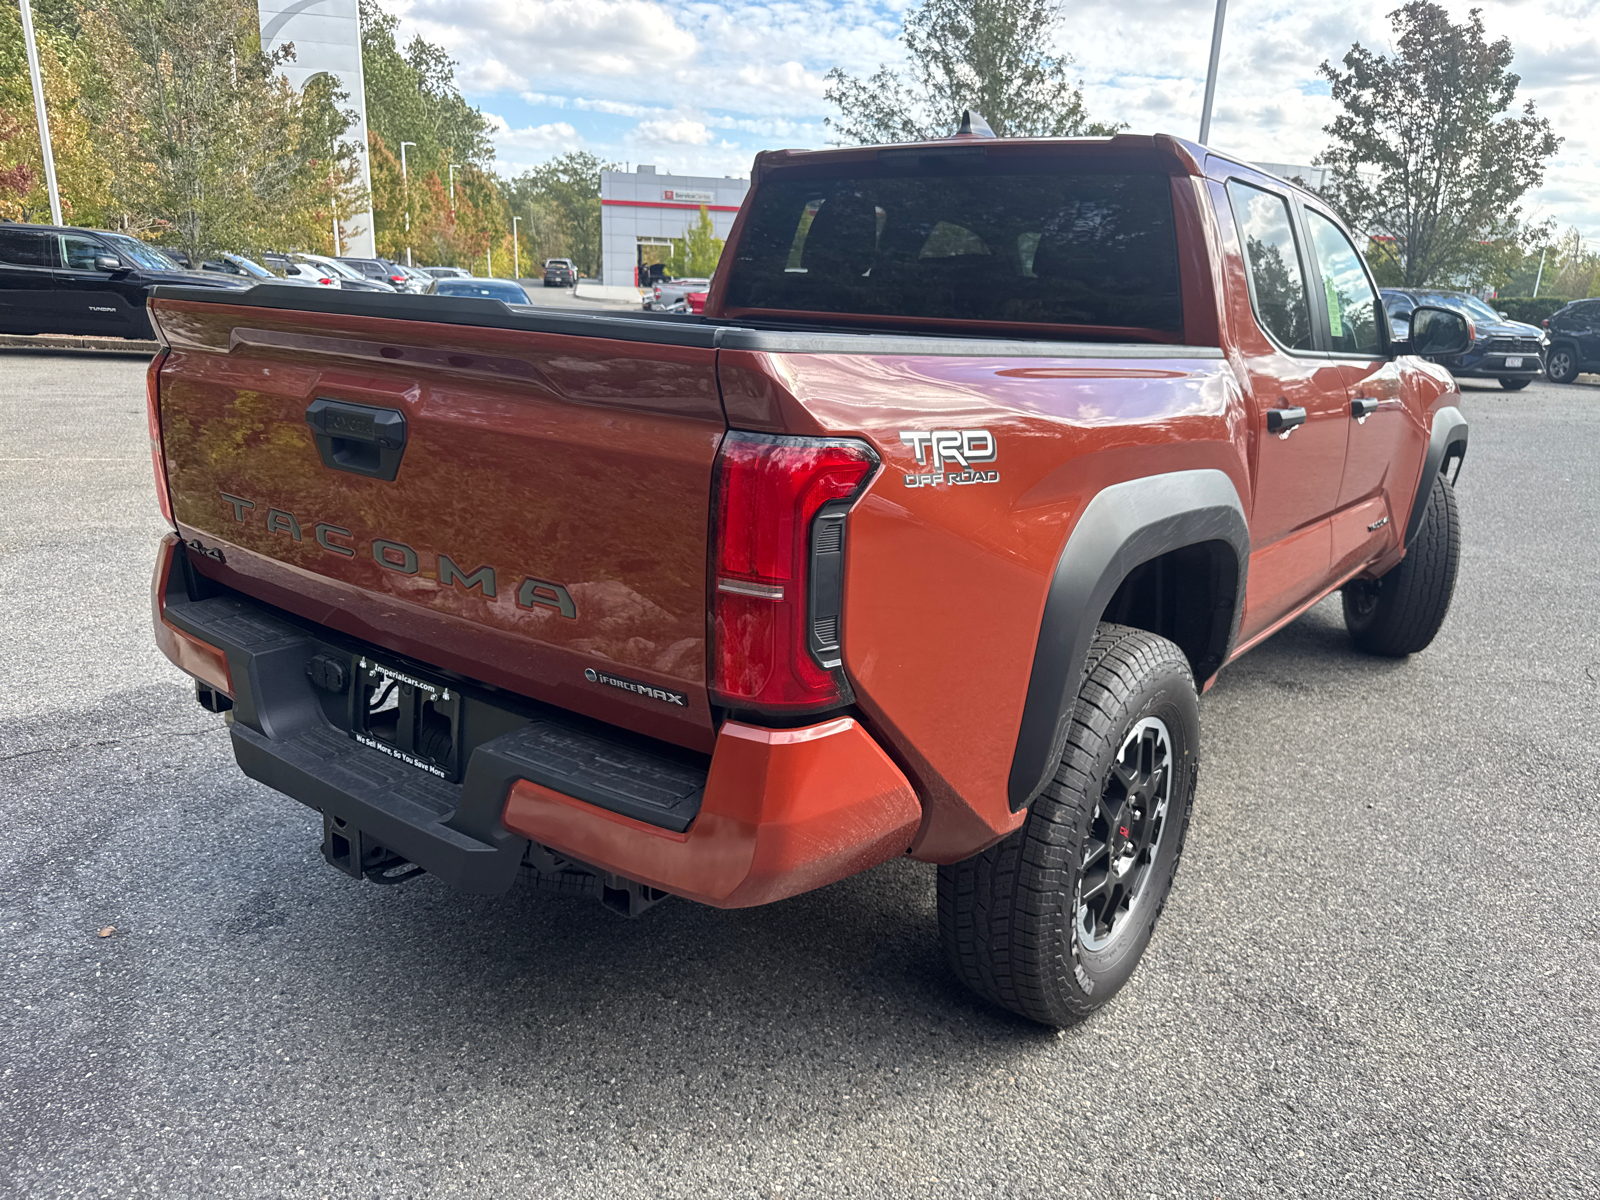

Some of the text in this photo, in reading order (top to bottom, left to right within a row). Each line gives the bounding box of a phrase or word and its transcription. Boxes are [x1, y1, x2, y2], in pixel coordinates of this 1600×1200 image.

[898, 429, 997, 474] TRD
[903, 469, 1000, 488] OFF ROAD
[220, 491, 577, 620] TACOMA
[374, 663, 435, 693] Imperialcars.com
[356, 734, 445, 778] We Sell More, So You Save More
